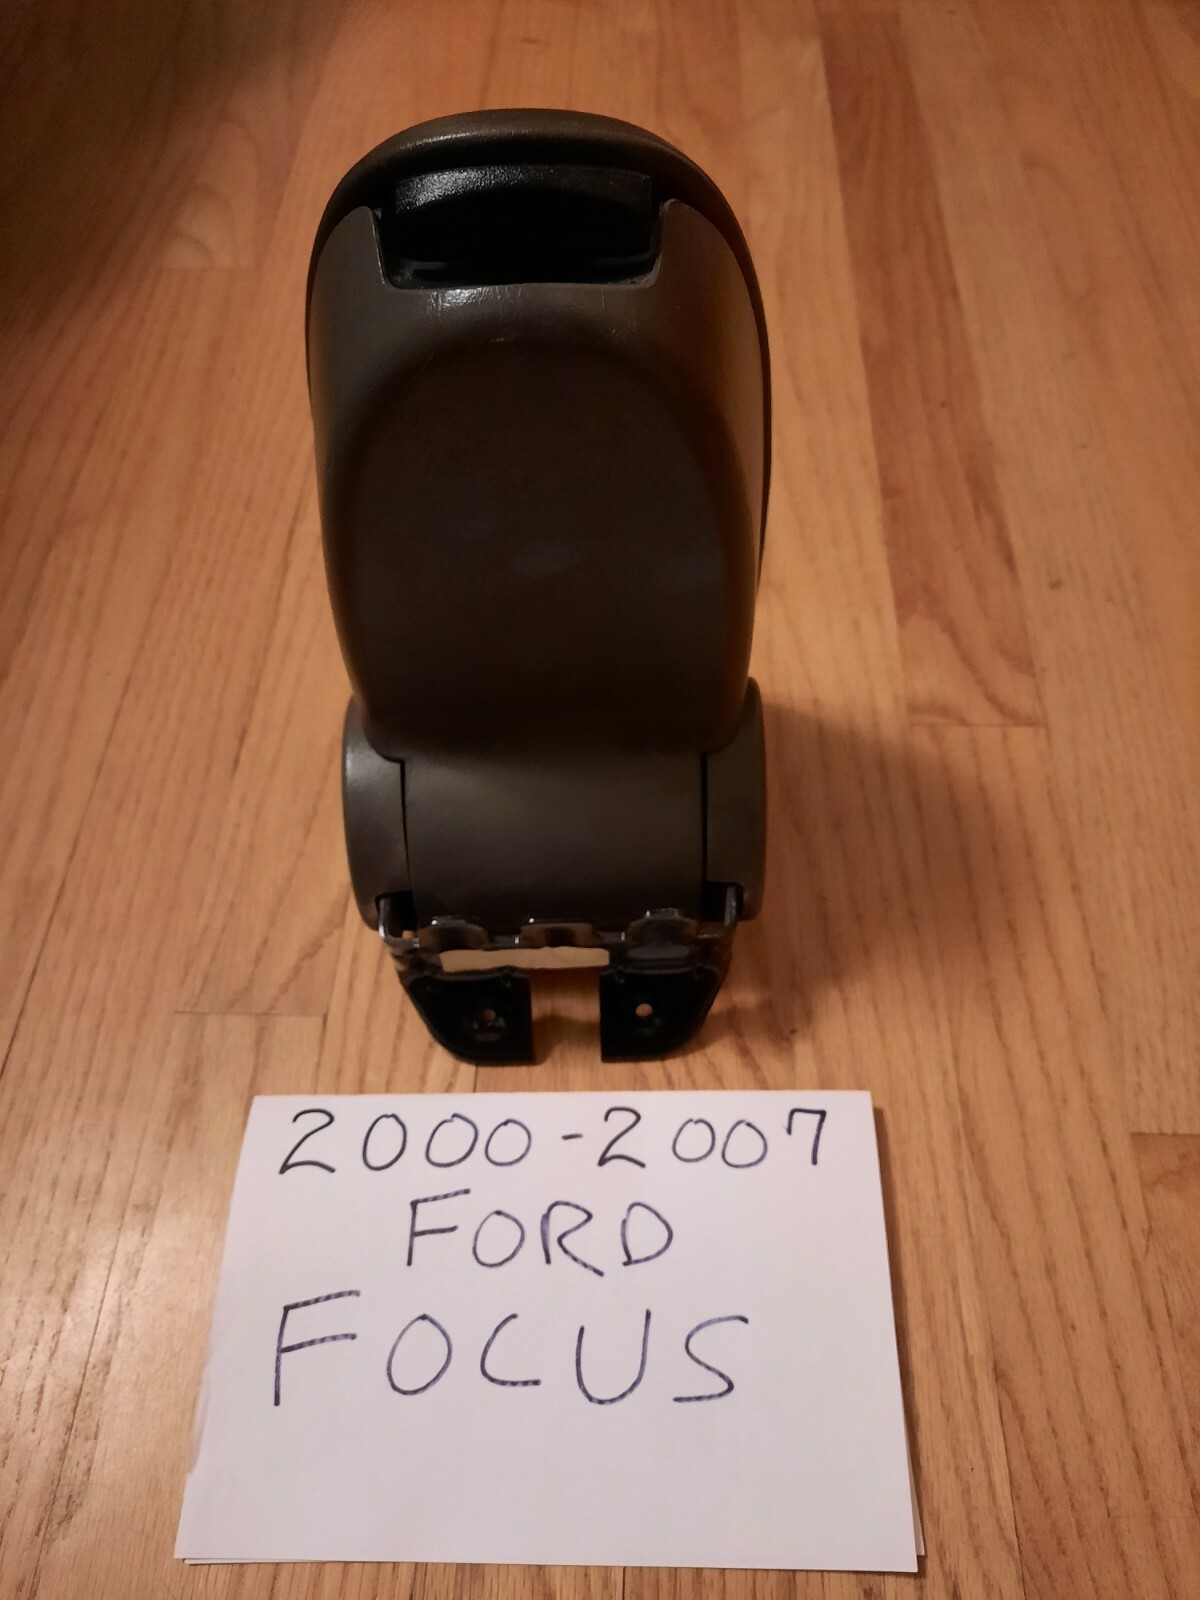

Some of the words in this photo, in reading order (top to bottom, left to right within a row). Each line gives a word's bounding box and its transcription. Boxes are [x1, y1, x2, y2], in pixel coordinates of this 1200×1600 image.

[278, 1107, 828, 1175] 2000-2007
[406, 1187, 674, 1278] FORD
[273, 1289, 750, 1408] FOCUS
